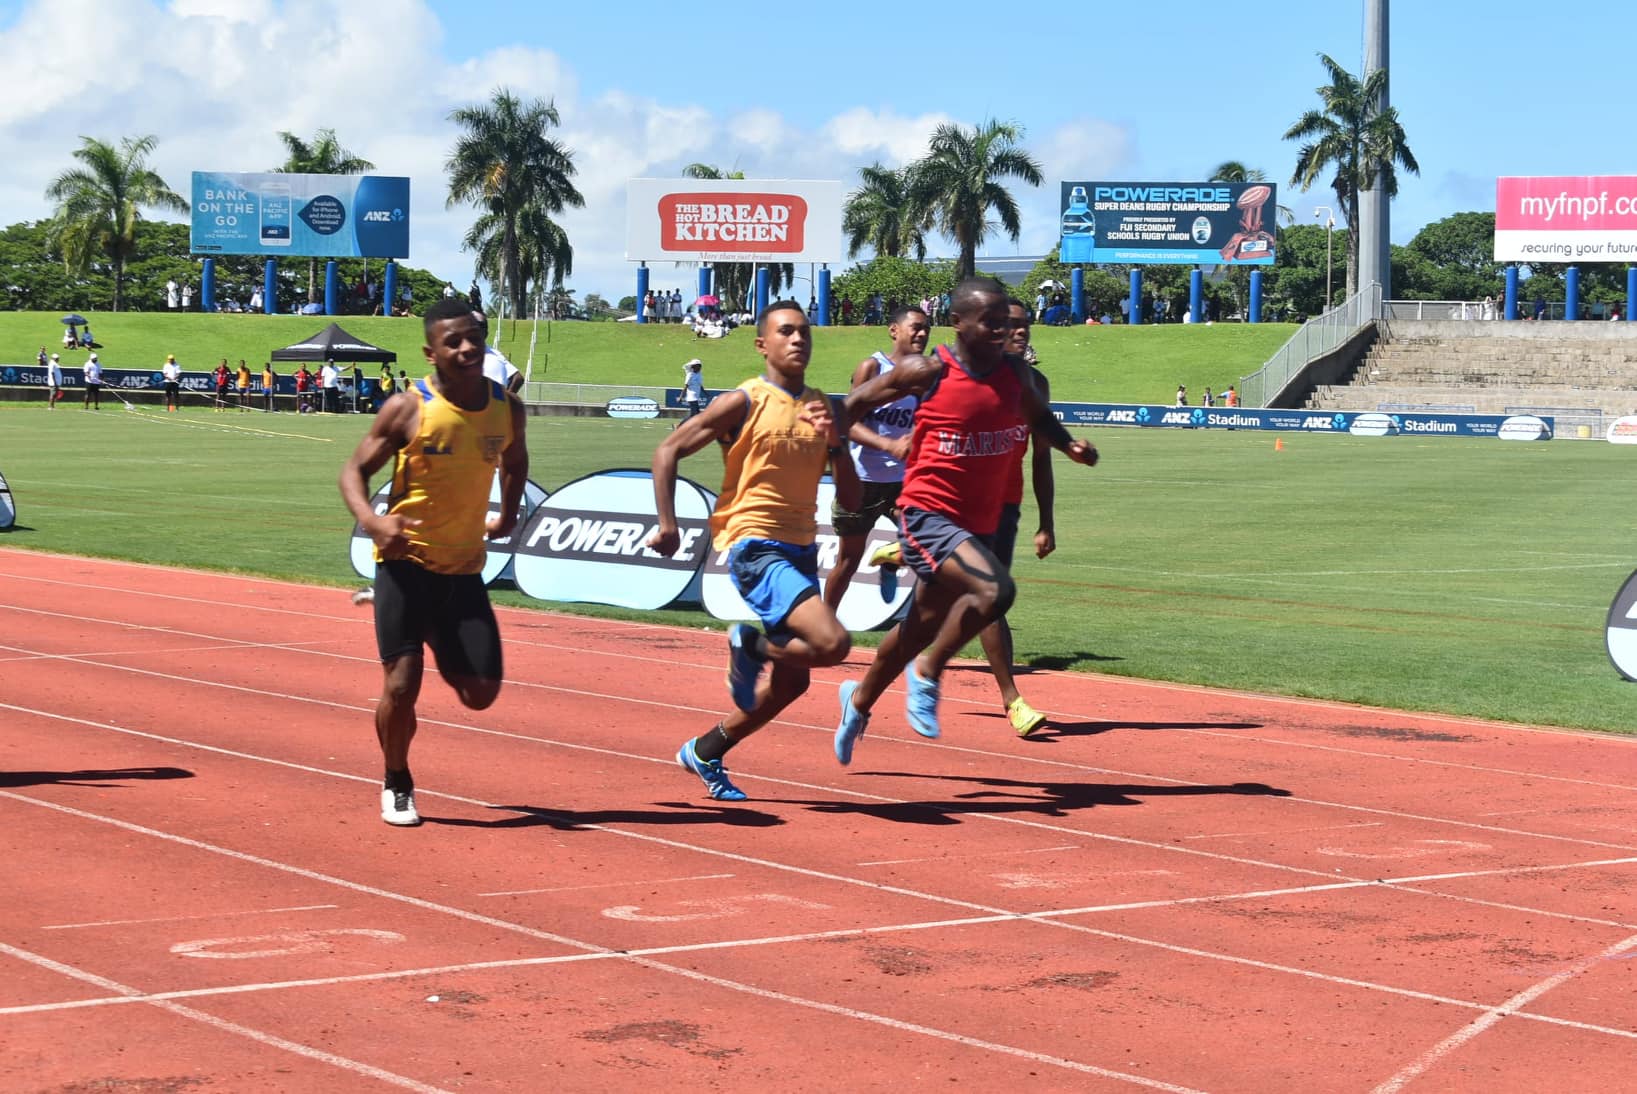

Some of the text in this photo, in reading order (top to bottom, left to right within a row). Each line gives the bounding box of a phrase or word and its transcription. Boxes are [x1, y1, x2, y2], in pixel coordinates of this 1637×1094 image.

[205, 189, 247, 200] BANK
[1095, 187, 1231, 202] POWERADE
[198, 202, 254, 214] ON THE
[675, 204, 699, 213] THE
[1095, 202, 1231, 212] SUPER DEANS RUGBY CHAMPIONSHIP
[363, 211, 391, 221] ANZ
[675, 213, 700, 222] HOT
[700, 204, 789, 223] BREAD
[215, 216, 237, 226] GO
[675, 223, 788, 241] KITCHEN
[1120, 223, 1176, 232] FIJI SECONDARY
[1107, 231, 1190, 241] SCHOOLS RUGBY UNION
[1521, 242, 1572, 256] securing
[1576, 244, 1604, 256] your
[120, 375, 150, 387] ANZ
[179, 377, 208, 389] ANZ
[608, 403, 657, 411] POWERADE
[1106, 410, 1136, 422] ANZ
[1161, 412, 1260, 426] ANZ Stadium
[1302, 416, 1332, 428] ANZ
[1405, 420, 1457, 432] Stadium
[526, 516, 705, 562] POWERAE
